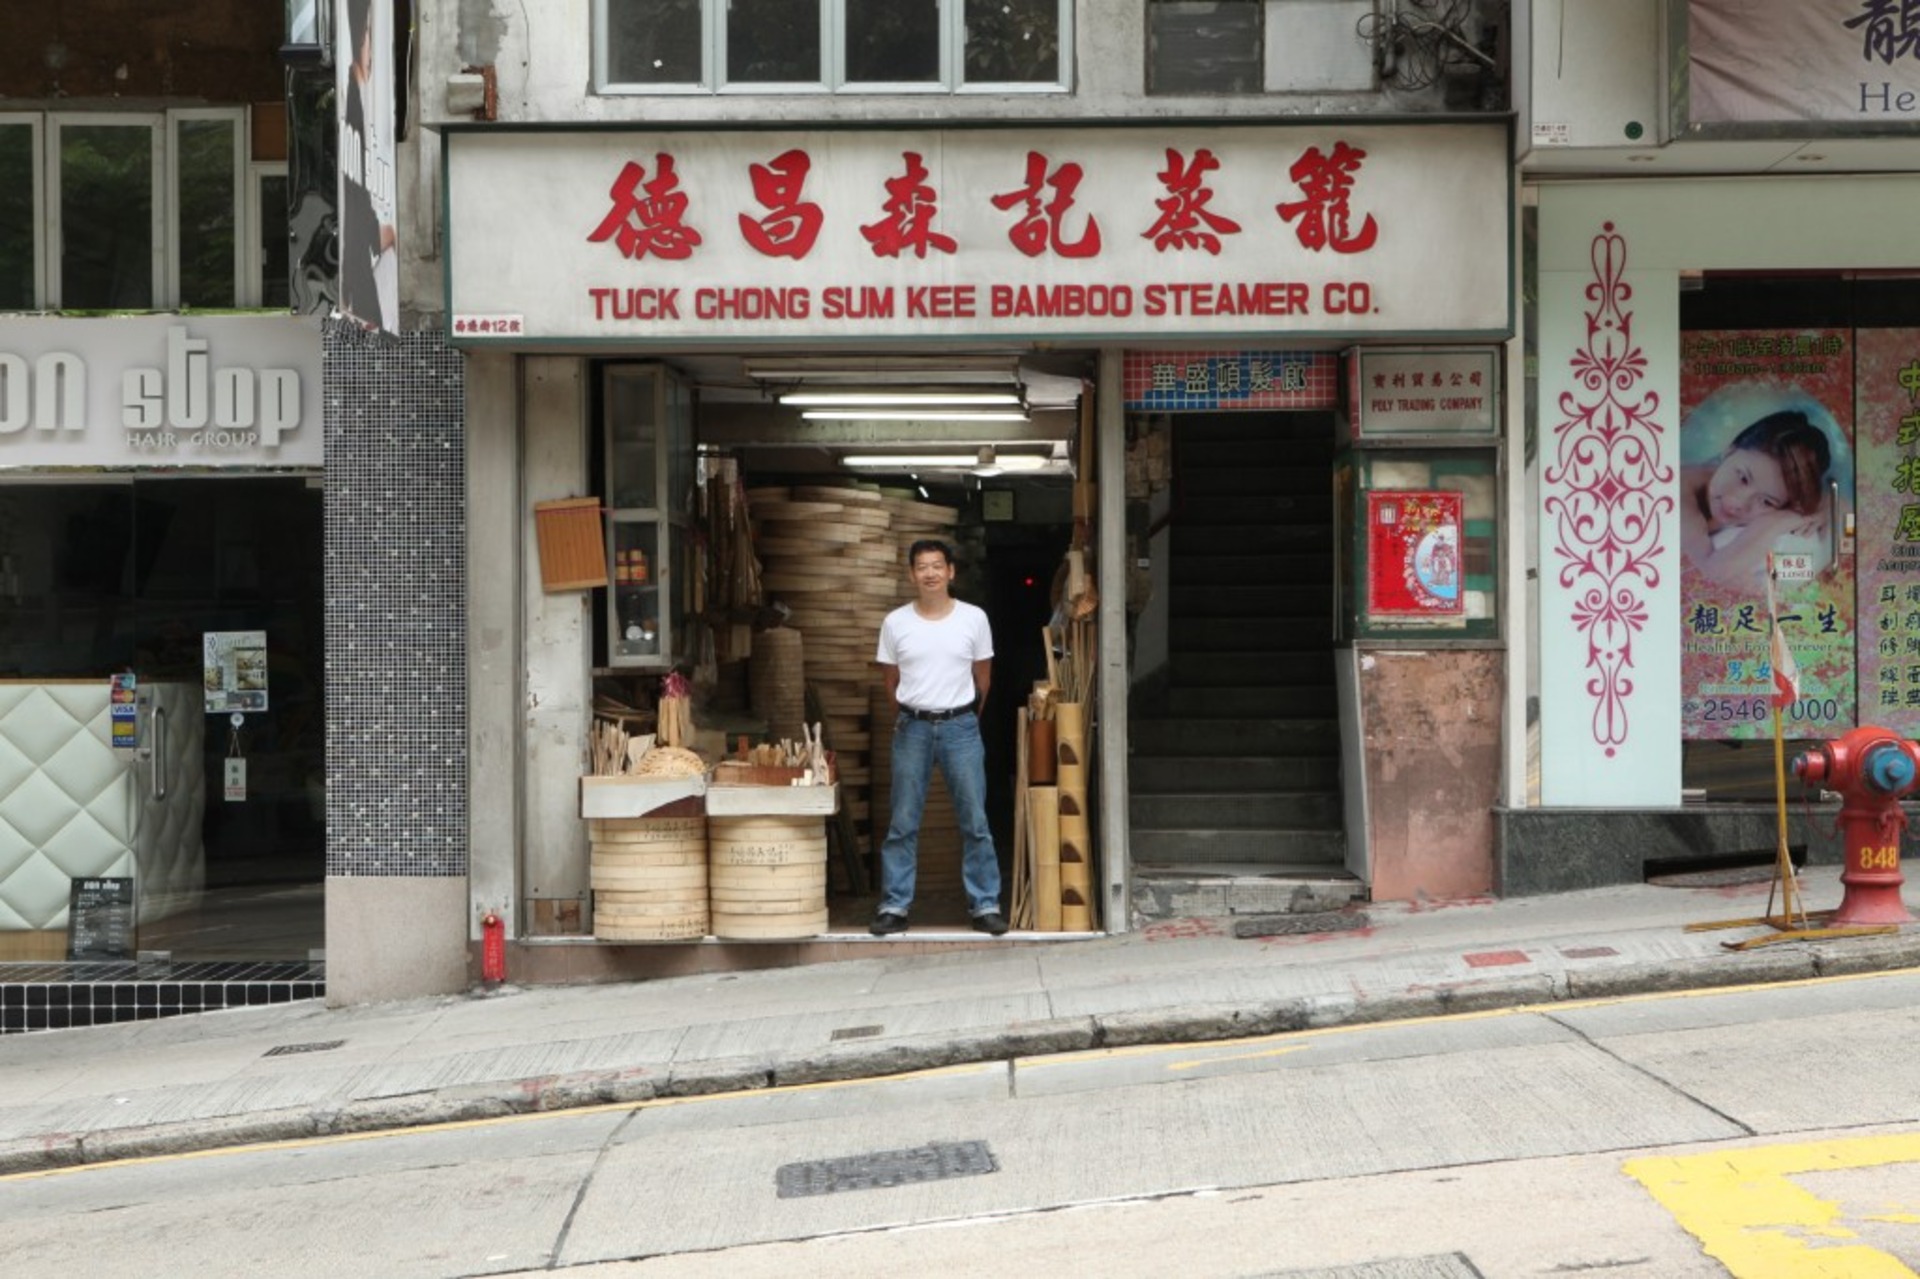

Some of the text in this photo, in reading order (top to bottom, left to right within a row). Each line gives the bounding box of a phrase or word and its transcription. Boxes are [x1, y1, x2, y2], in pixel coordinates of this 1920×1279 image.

[587, 141, 1379, 260] 德昌森記蒸籠
[589, 281, 1379, 321] TUCK CHONG SUM KEE BAMBOO STEAMER CO.
[122, 326, 300, 447] stop
[1151, 359, 1308, 394] 華盛頓髮廊
[1398, 397, 1436, 412] TRADING
[1440, 396, 1483, 411] COMPANY
[126, 431, 258, 447] HAIR GROUP
[1688, 603, 1839, 635] 靚足一生
[1704, 699, 1838, 721] 2546 000
[1860, 847, 1897, 869] 848
